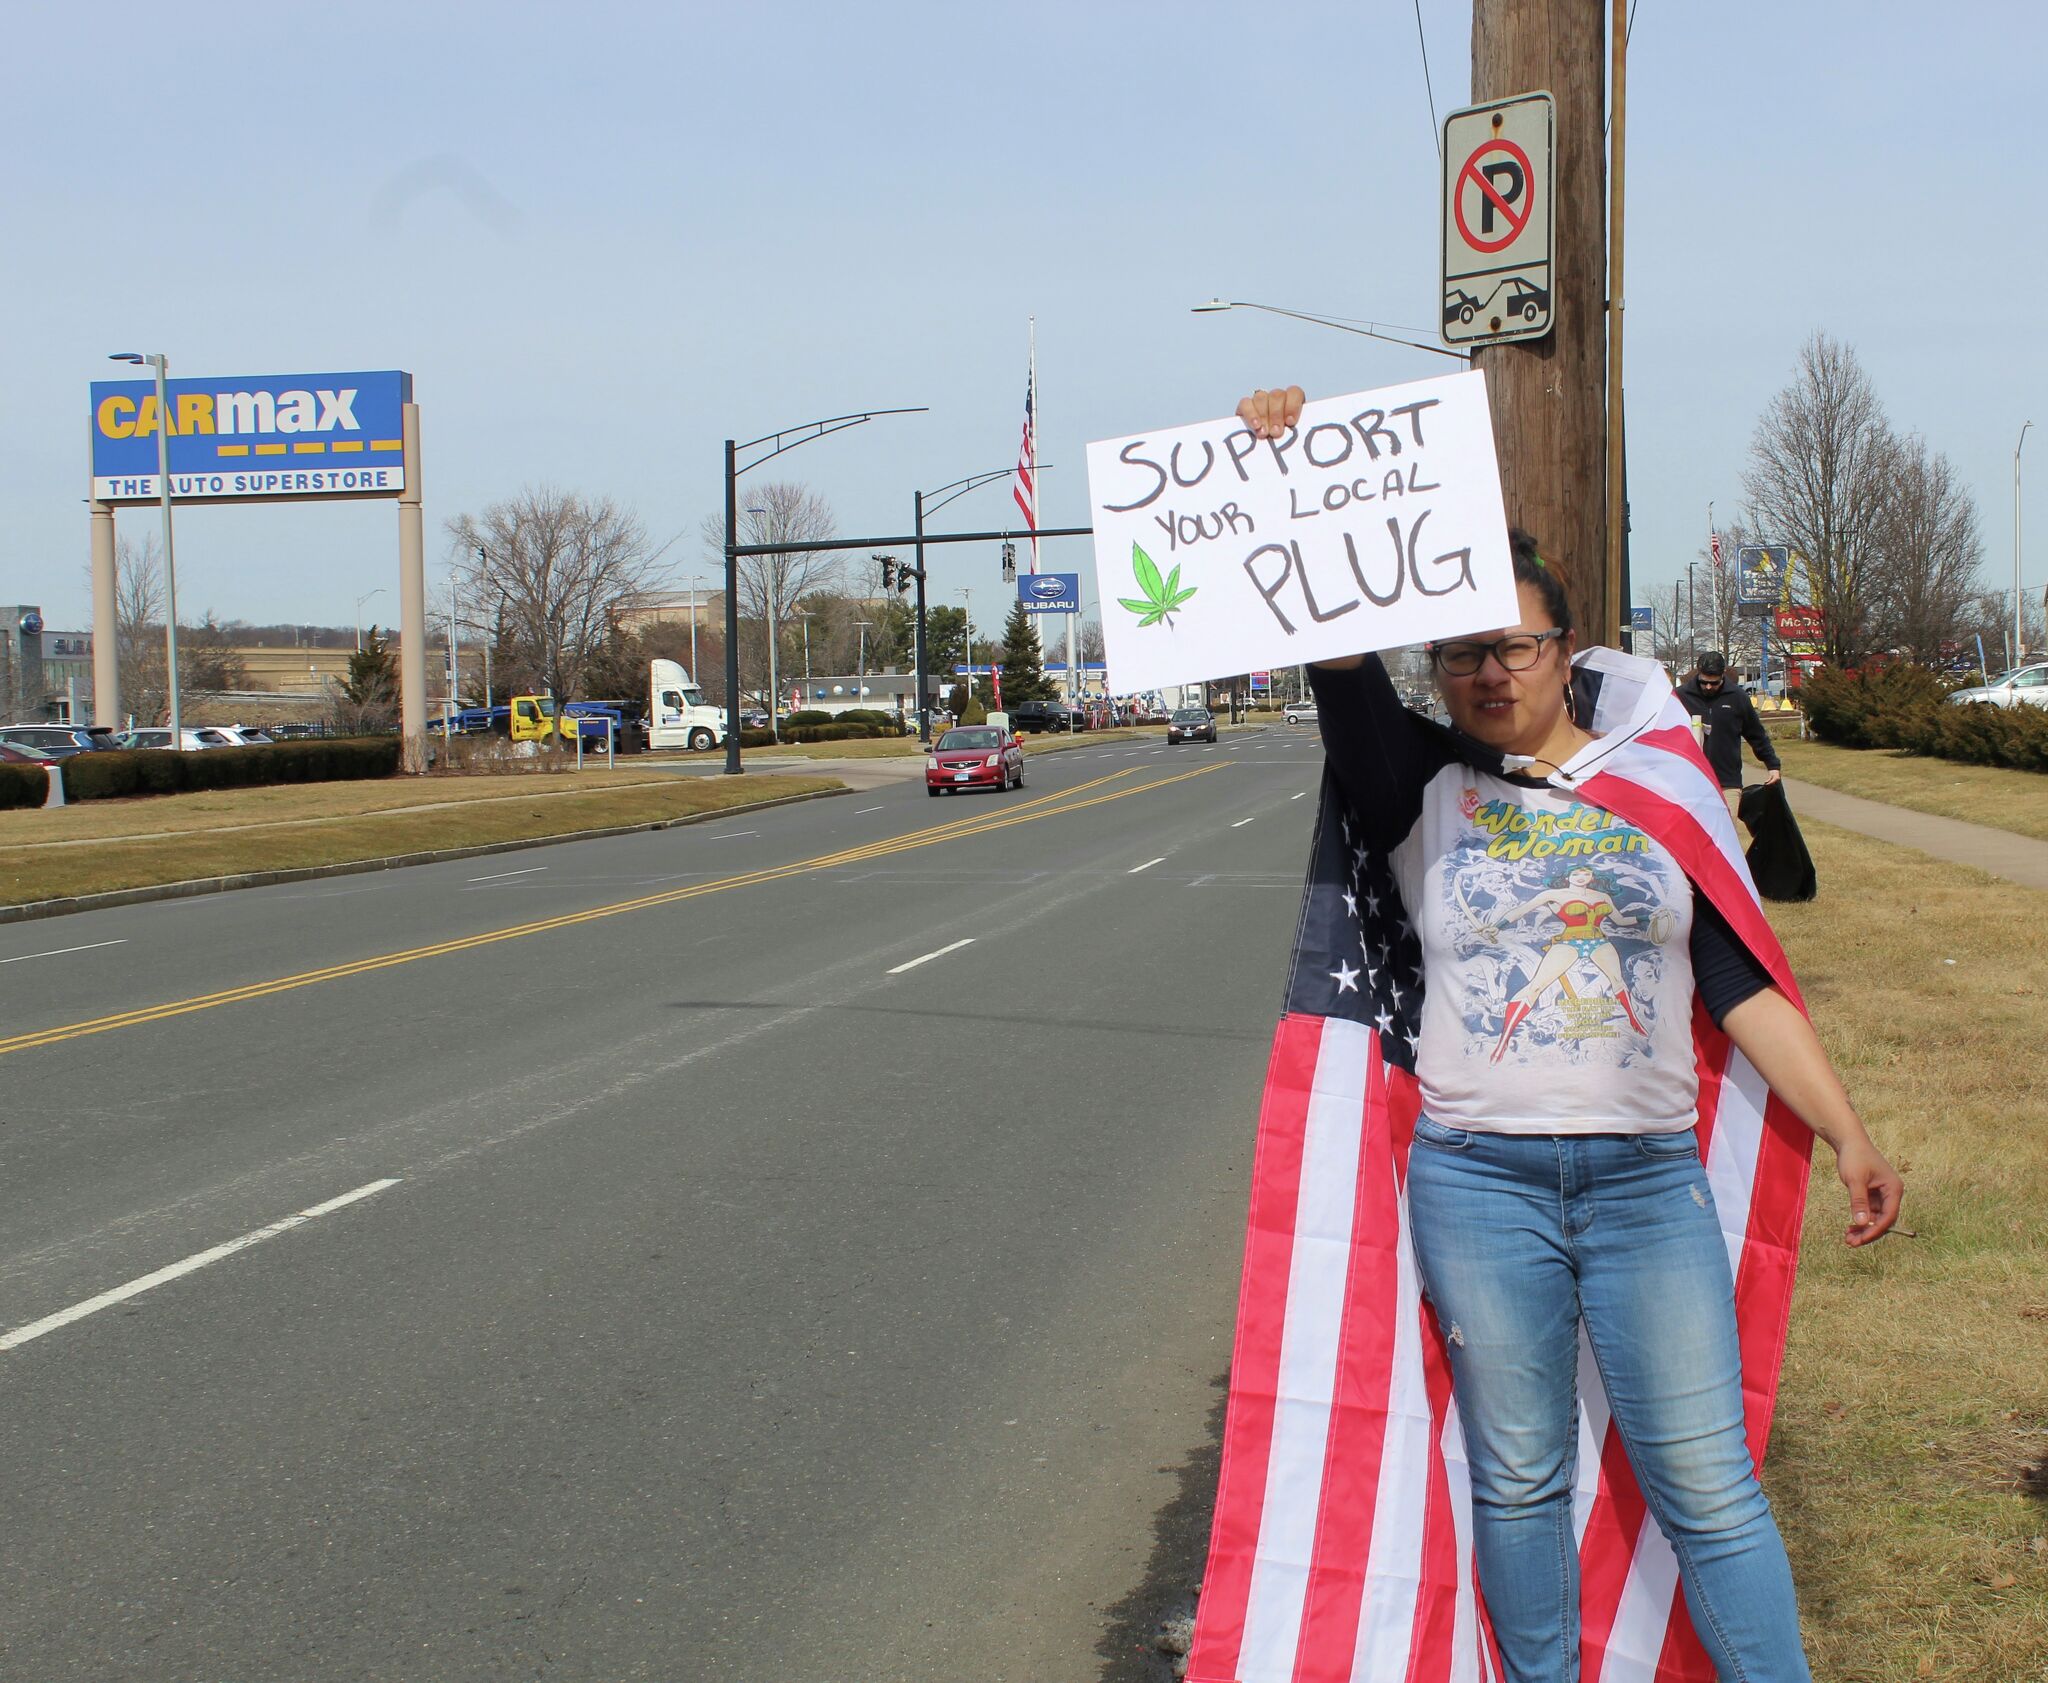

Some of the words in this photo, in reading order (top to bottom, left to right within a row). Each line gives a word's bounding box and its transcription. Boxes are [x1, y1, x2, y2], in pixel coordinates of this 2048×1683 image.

[97, 388, 361, 439] CARmax
[1102, 398, 1440, 512] SUPPORT
[109, 478, 152, 495] THE
[167, 475, 224, 494] AUTO
[234, 470, 388, 492] SUPERSTORE
[1154, 502, 1254, 551] YOUR
[1289, 462, 1440, 519] LOCAL
[1243, 508, 1477, 635] PLUG
[1022, 600, 1075, 610] SUBARU
[1472, 802, 1616, 834] Wonder
[1486, 831, 1649, 860] Woman
